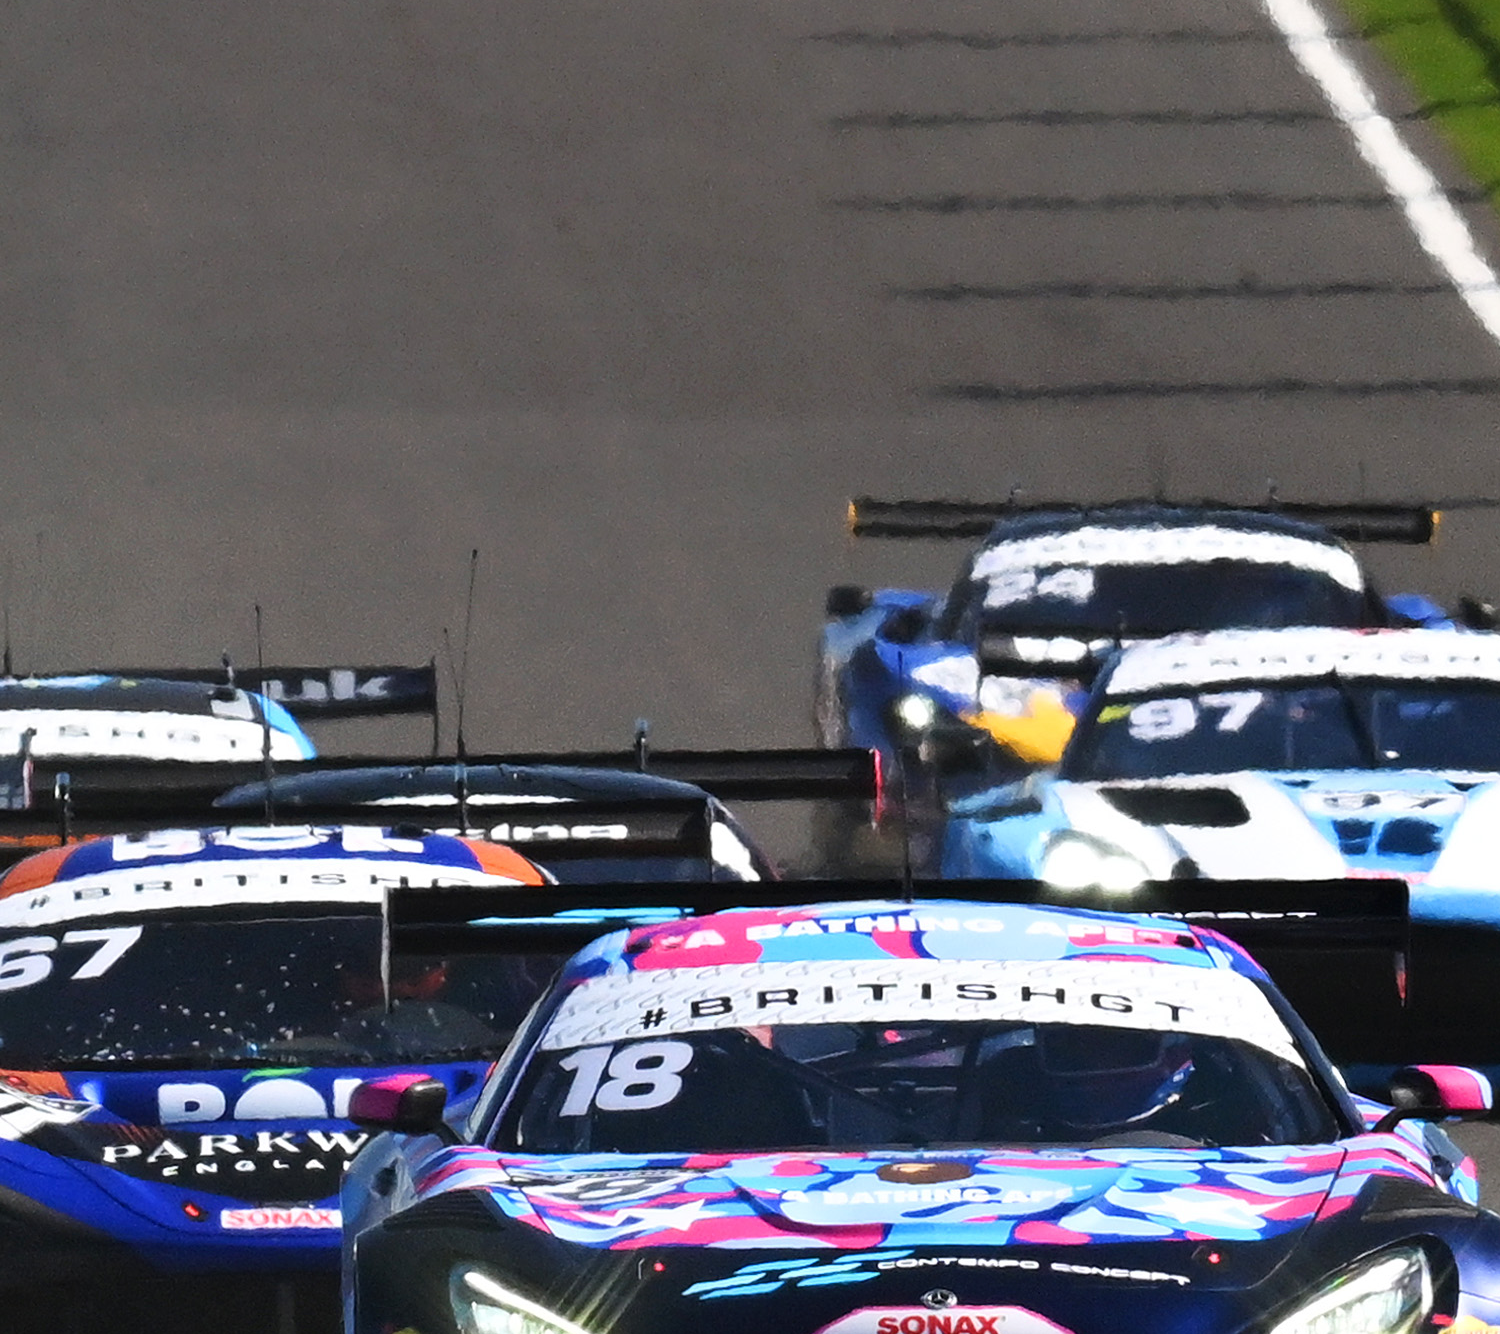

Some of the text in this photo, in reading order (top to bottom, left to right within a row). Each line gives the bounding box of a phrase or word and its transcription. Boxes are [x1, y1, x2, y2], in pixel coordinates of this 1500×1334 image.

[1129, 691, 1262, 741] 97
[746, 917, 1004, 942] BATHING
[640, 983, 1195, 1029] #BRITISHGT
[558, 1041, 694, 1117] 18
[102, 1130, 368, 1164] PARKW
[162, 1160, 352, 1177] ENGLA
[823, 1187, 991, 1205] BATHING
[226, 1209, 333, 1226] SONAX
[877, 1256, 1192, 1286] CONTEMPO CONCEPT
